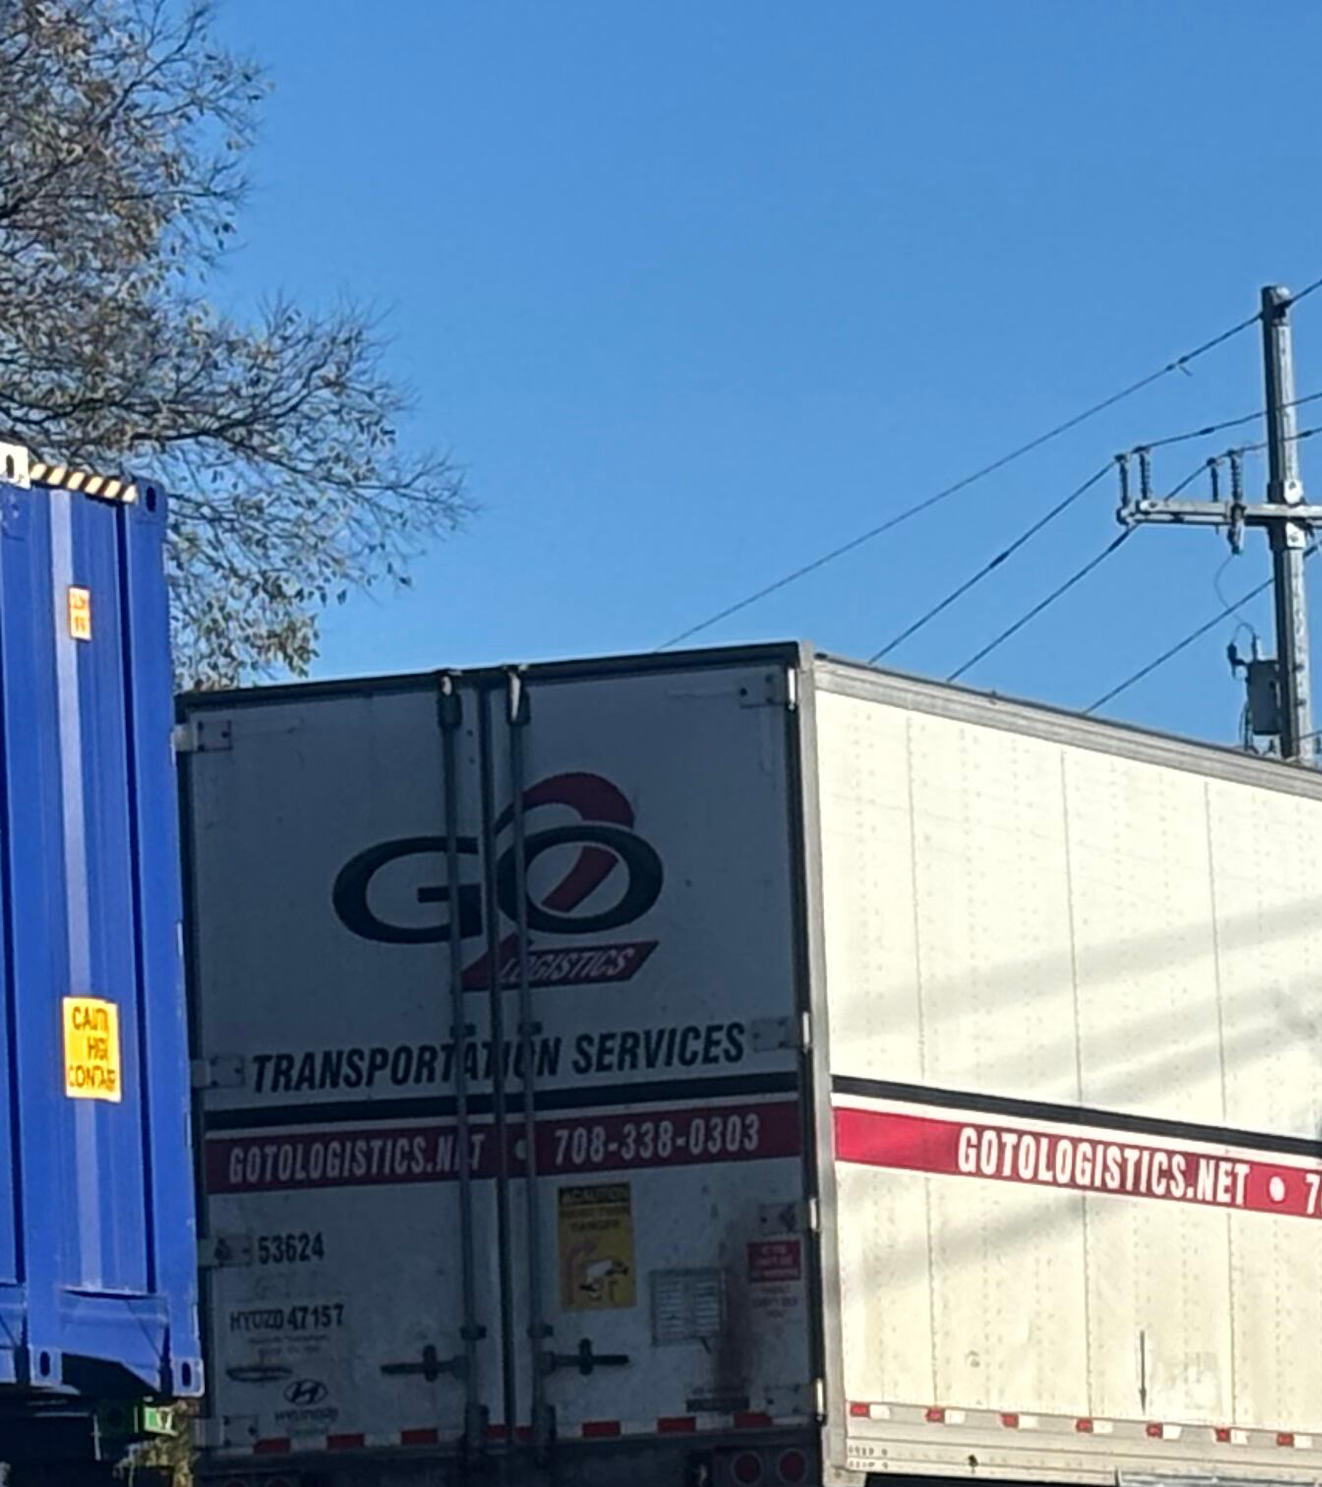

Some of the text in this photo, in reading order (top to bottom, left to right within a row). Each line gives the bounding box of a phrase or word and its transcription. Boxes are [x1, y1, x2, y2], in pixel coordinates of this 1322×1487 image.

[573, 1021, 746, 1079] SERVICES
[555, 1112, 760, 1166] 708-338-0303
[957, 1126, 1251, 1208] GOTOLOGISTICS.NET
[257, 1231, 325, 1265] 53624
